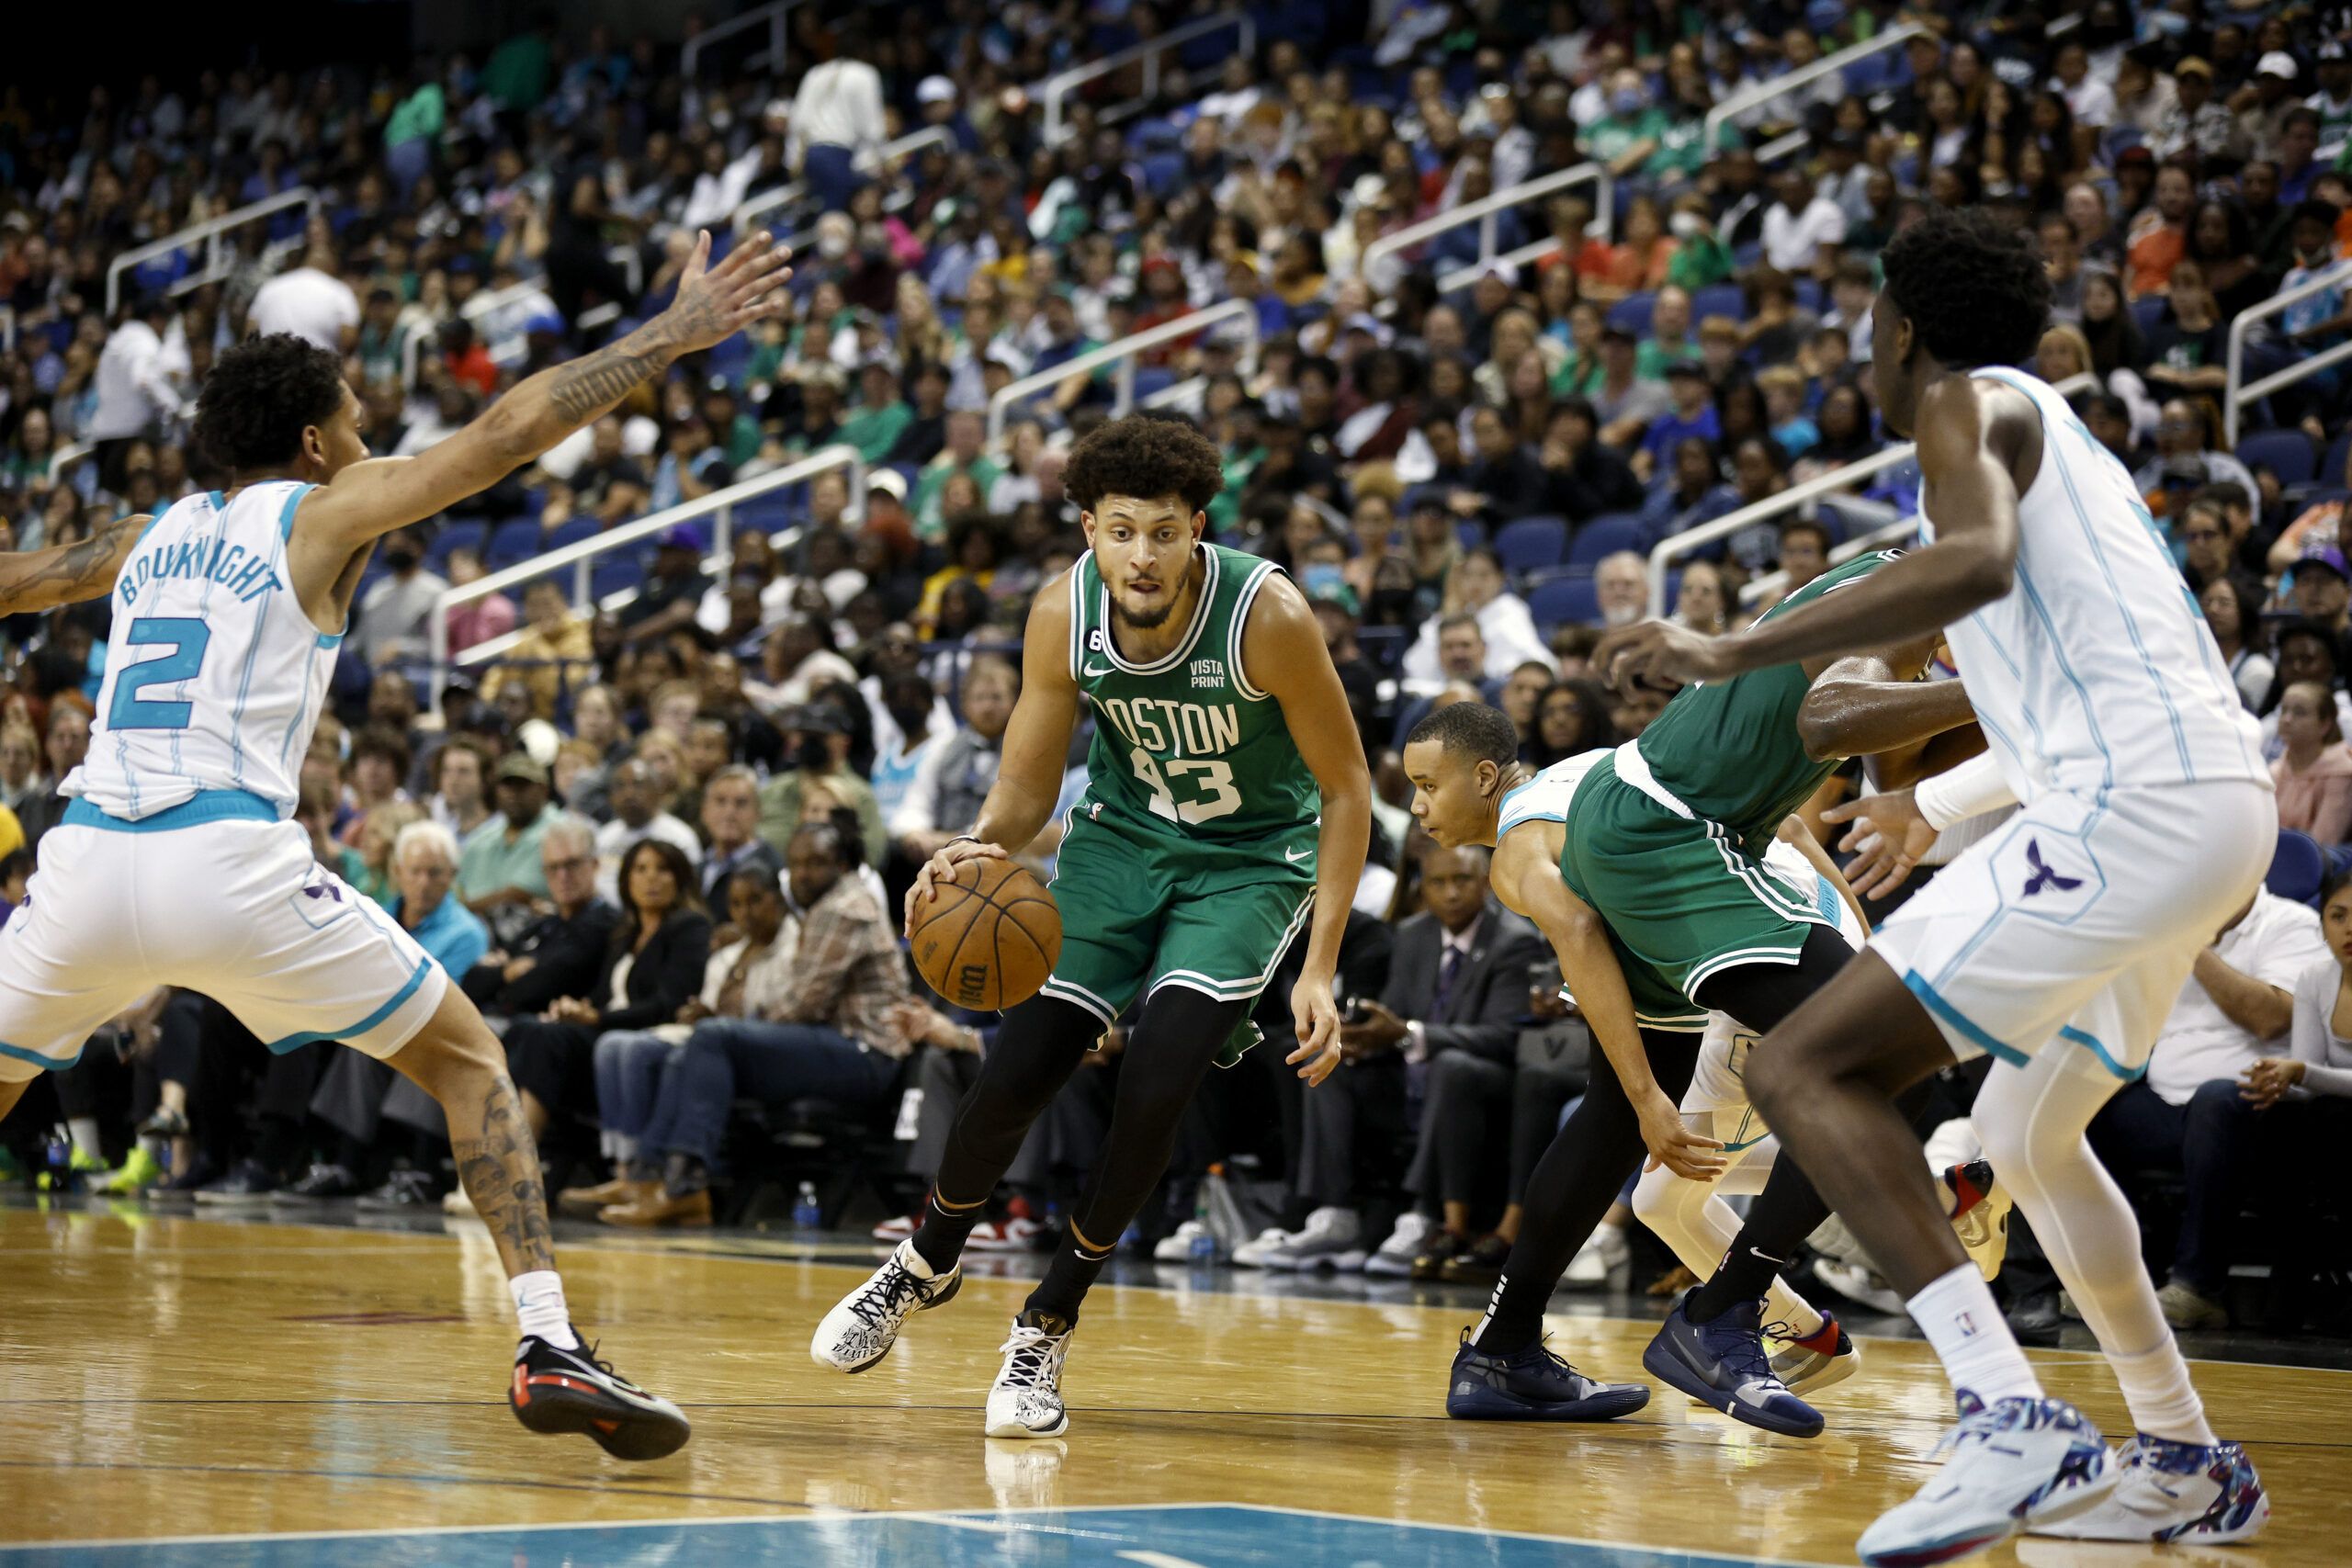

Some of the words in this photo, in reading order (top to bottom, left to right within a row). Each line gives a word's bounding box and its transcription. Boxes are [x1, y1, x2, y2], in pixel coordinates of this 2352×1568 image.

[119, 536, 283, 606] BOUKNIGHT
[1089, 630, 1102, 651] 6
[1190, 660, 1224, 677] VISTA
[107, 617, 211, 731] 2
[1191, 677, 1225, 688] PRINT
[1089, 697, 1239, 759] OSTON
[1130, 747, 1242, 825] 43
